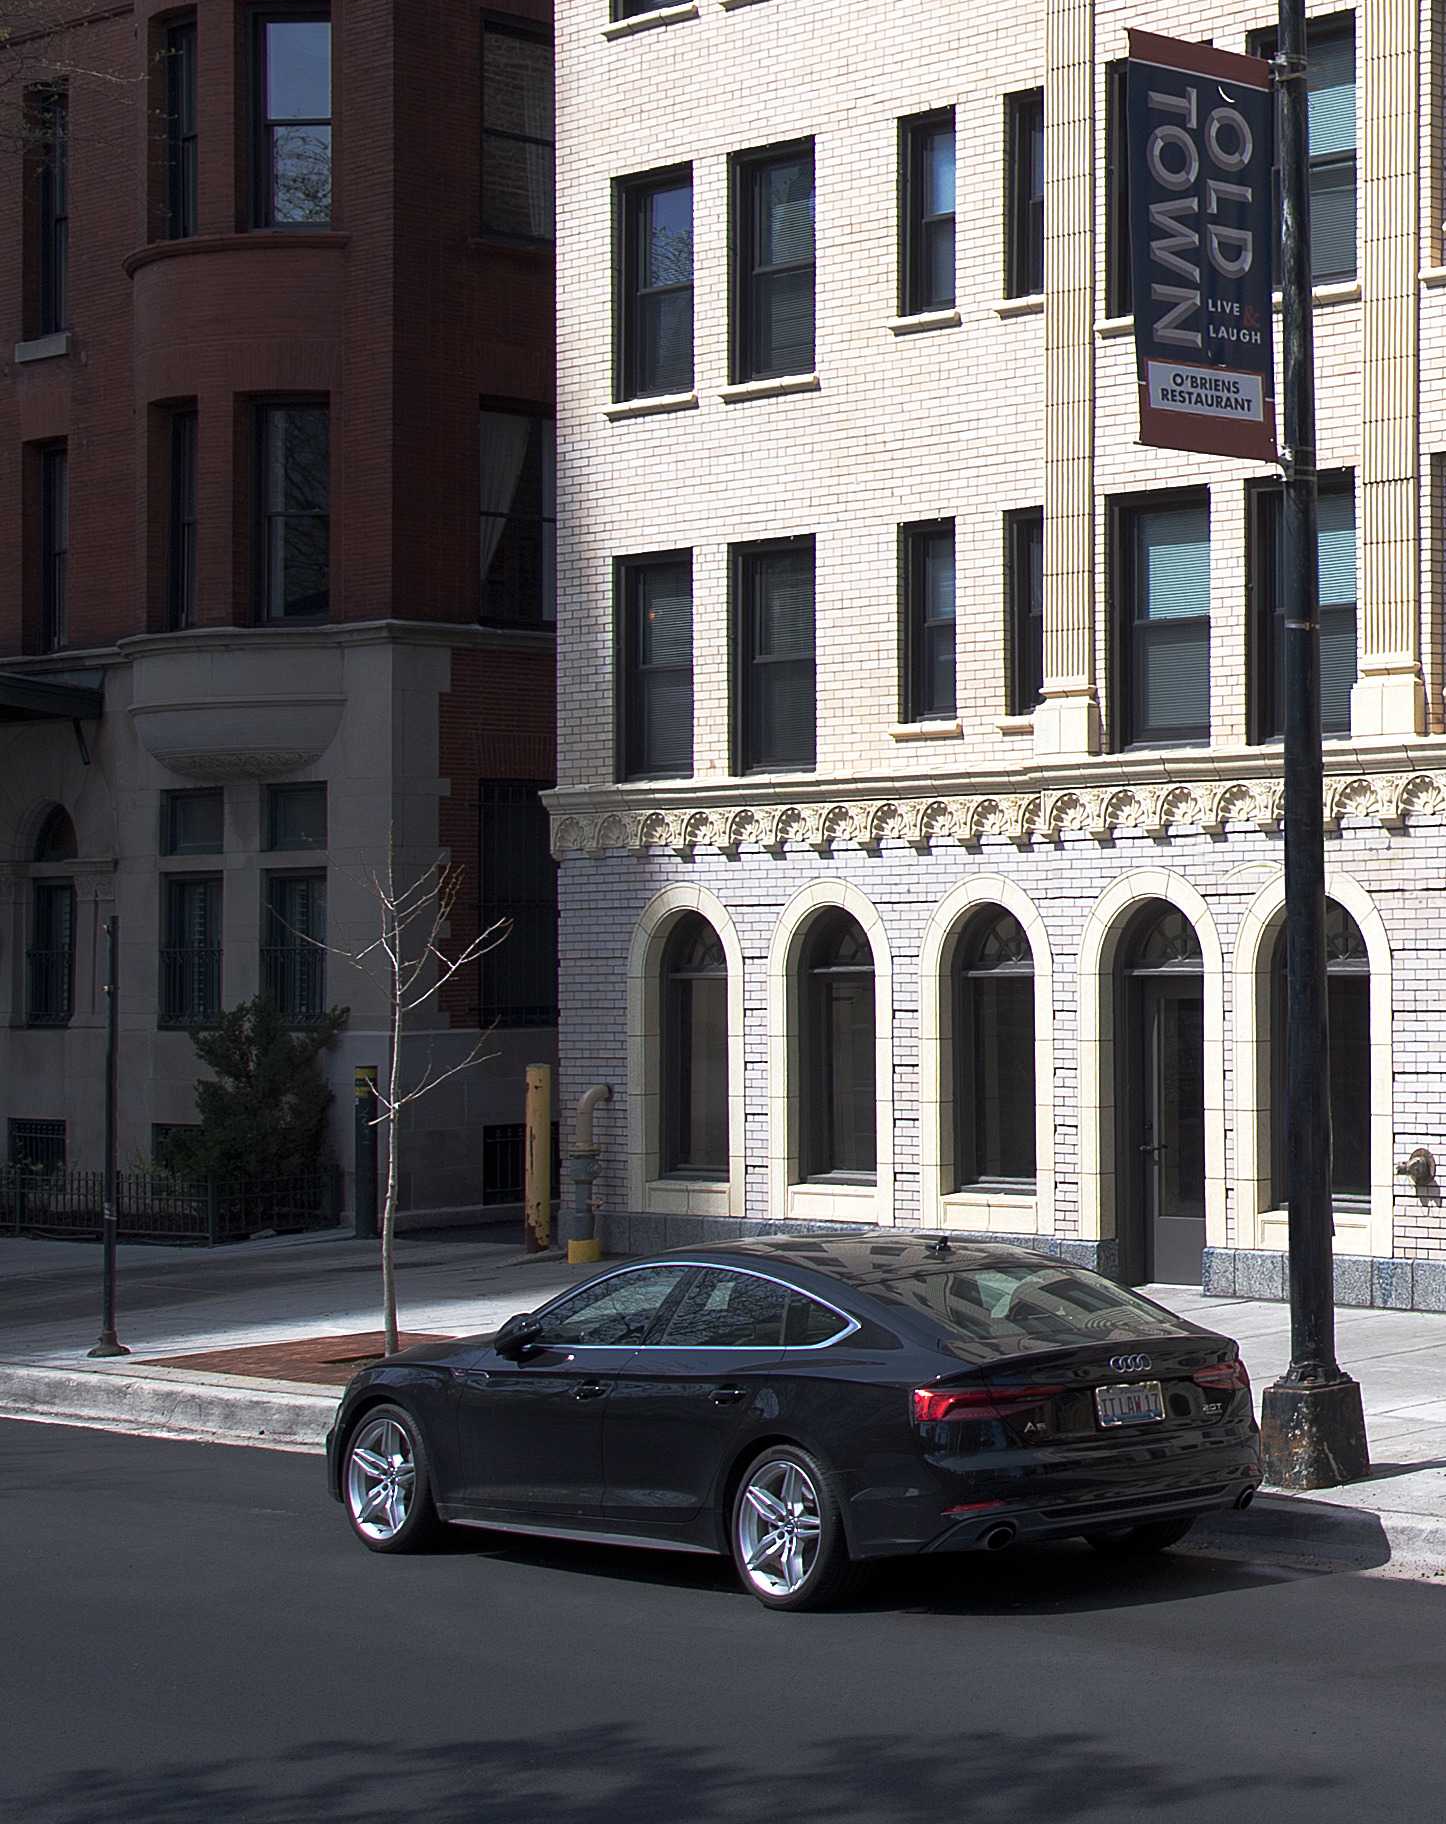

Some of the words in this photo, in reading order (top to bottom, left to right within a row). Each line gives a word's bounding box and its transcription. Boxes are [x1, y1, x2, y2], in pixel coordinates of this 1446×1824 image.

[1204, 107, 1253, 278] OLD
[1147, 87, 1201, 348] TOWN
[1208, 298, 1240, 316] LIVE
[1209, 324, 1261, 345] LAUGH
[1172, 373, 1240, 394] O'BRIENS
[1160, 387, 1253, 413] RESTAURANT
